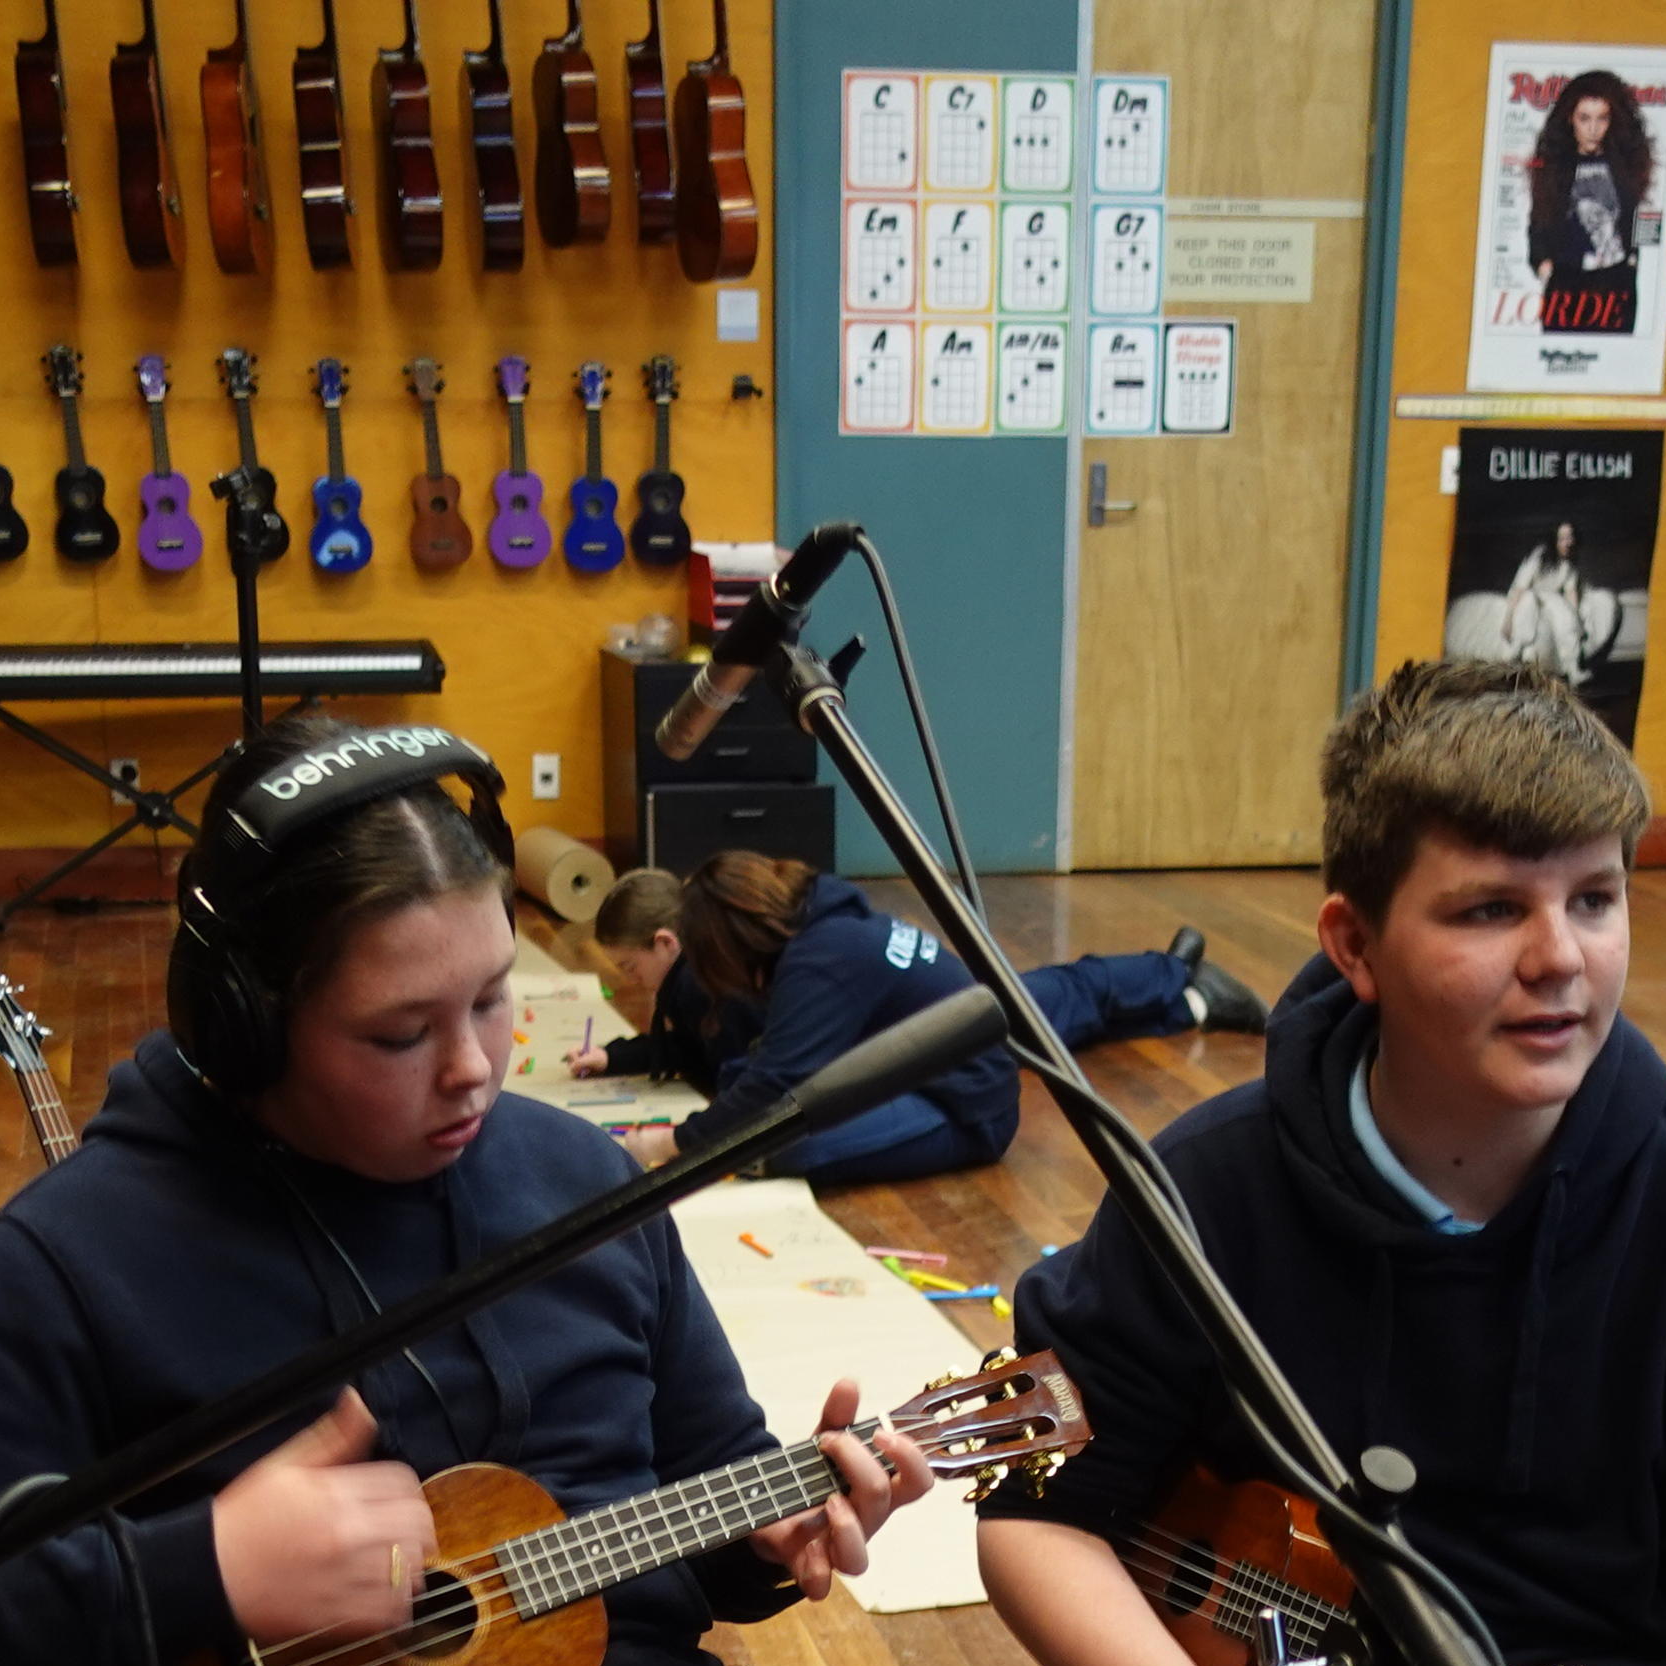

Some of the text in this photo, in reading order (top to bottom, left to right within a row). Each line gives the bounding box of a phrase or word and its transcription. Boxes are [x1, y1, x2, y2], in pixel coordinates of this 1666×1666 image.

[875, 85, 891, 108] C
[1030, 87, 1047, 112] D
[1113, 89, 1148, 114] Dm
[864, 208, 898, 233] Em
[951, 210, 967, 234] F
[1027, 212, 1045, 235] G
[1492, 290, 1629, 329] LORDE
[872, 330, 887, 353] A
[942, 331, 973, 354] Am
[1489, 447, 1632, 481] BILLIE EILISH
[260, 727, 455, 800] behringer
[1040, 1373, 1081, 1421] MAHALO
